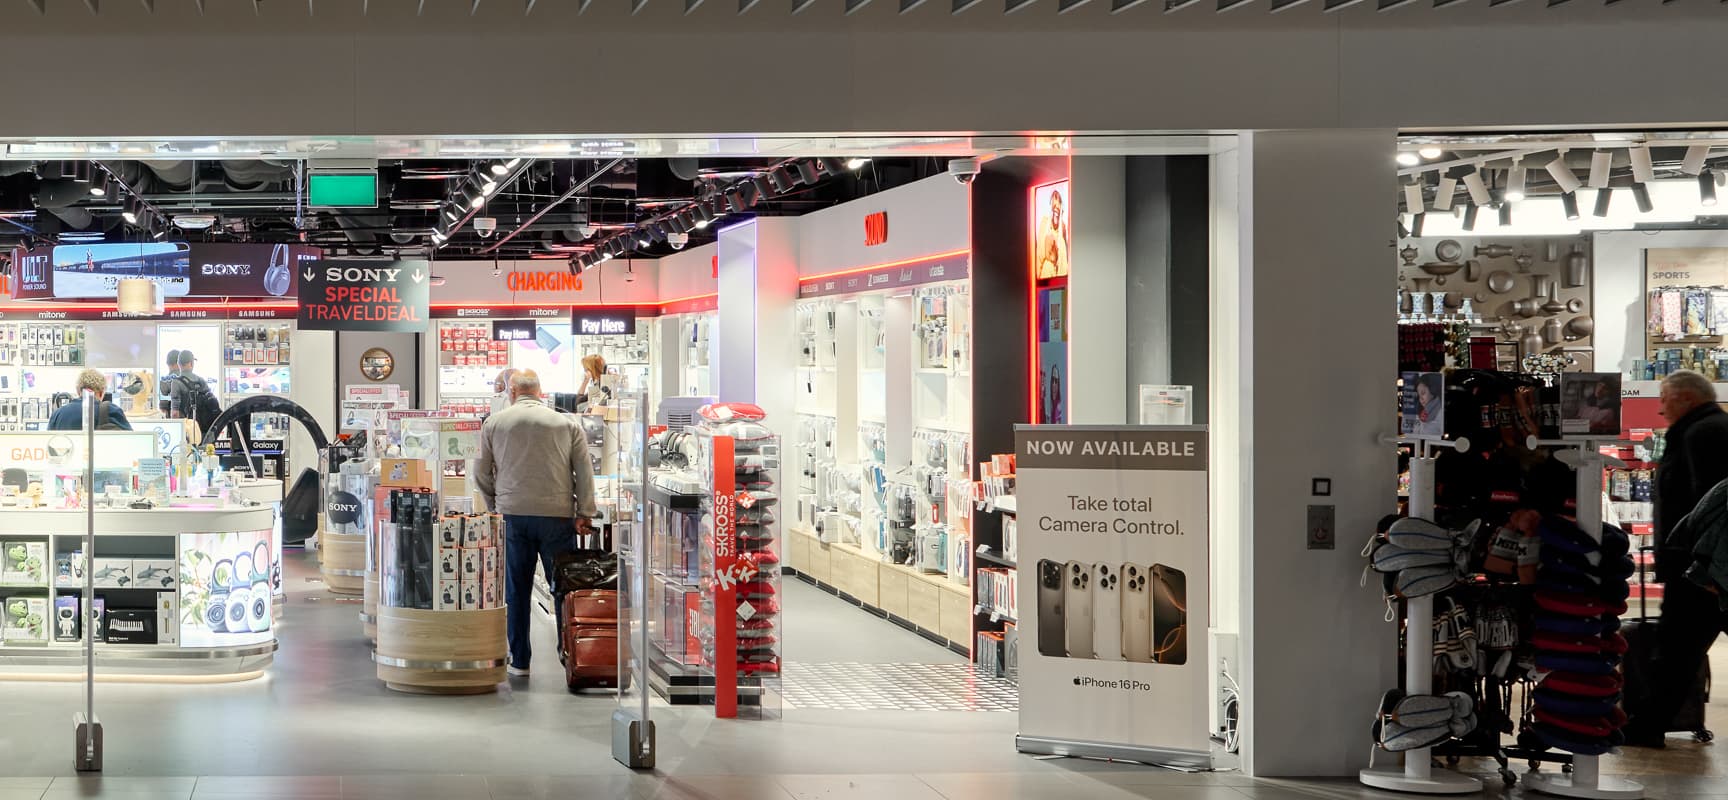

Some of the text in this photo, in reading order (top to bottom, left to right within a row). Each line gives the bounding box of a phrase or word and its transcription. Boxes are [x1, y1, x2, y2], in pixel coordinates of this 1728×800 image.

[326, 268, 402, 282] SONY
[507, 271, 584, 291] CHARGING
[1653, 271, 1690, 279] SPORTS
[325, 286, 402, 303] SPECIAL
[38, 311, 66, 319] mitone
[305, 303, 421, 321] TRAVELDEAL
[529, 308, 558, 316] mitone
[582, 319, 625, 333] Pay Here
[499, 329, 529, 341] Pay Here
[253, 441, 278, 449] Galaxy
[1026, 441, 1194, 456] NOW AVAILABLE
[328, 503, 357, 512] SONY
[1068, 495, 1152, 512] Take total
[716, 495, 728, 557] SKROSS
[1039, 516, 1184, 535] Camera Control.
[1082, 676, 1150, 691] iPhone 16 Pro
